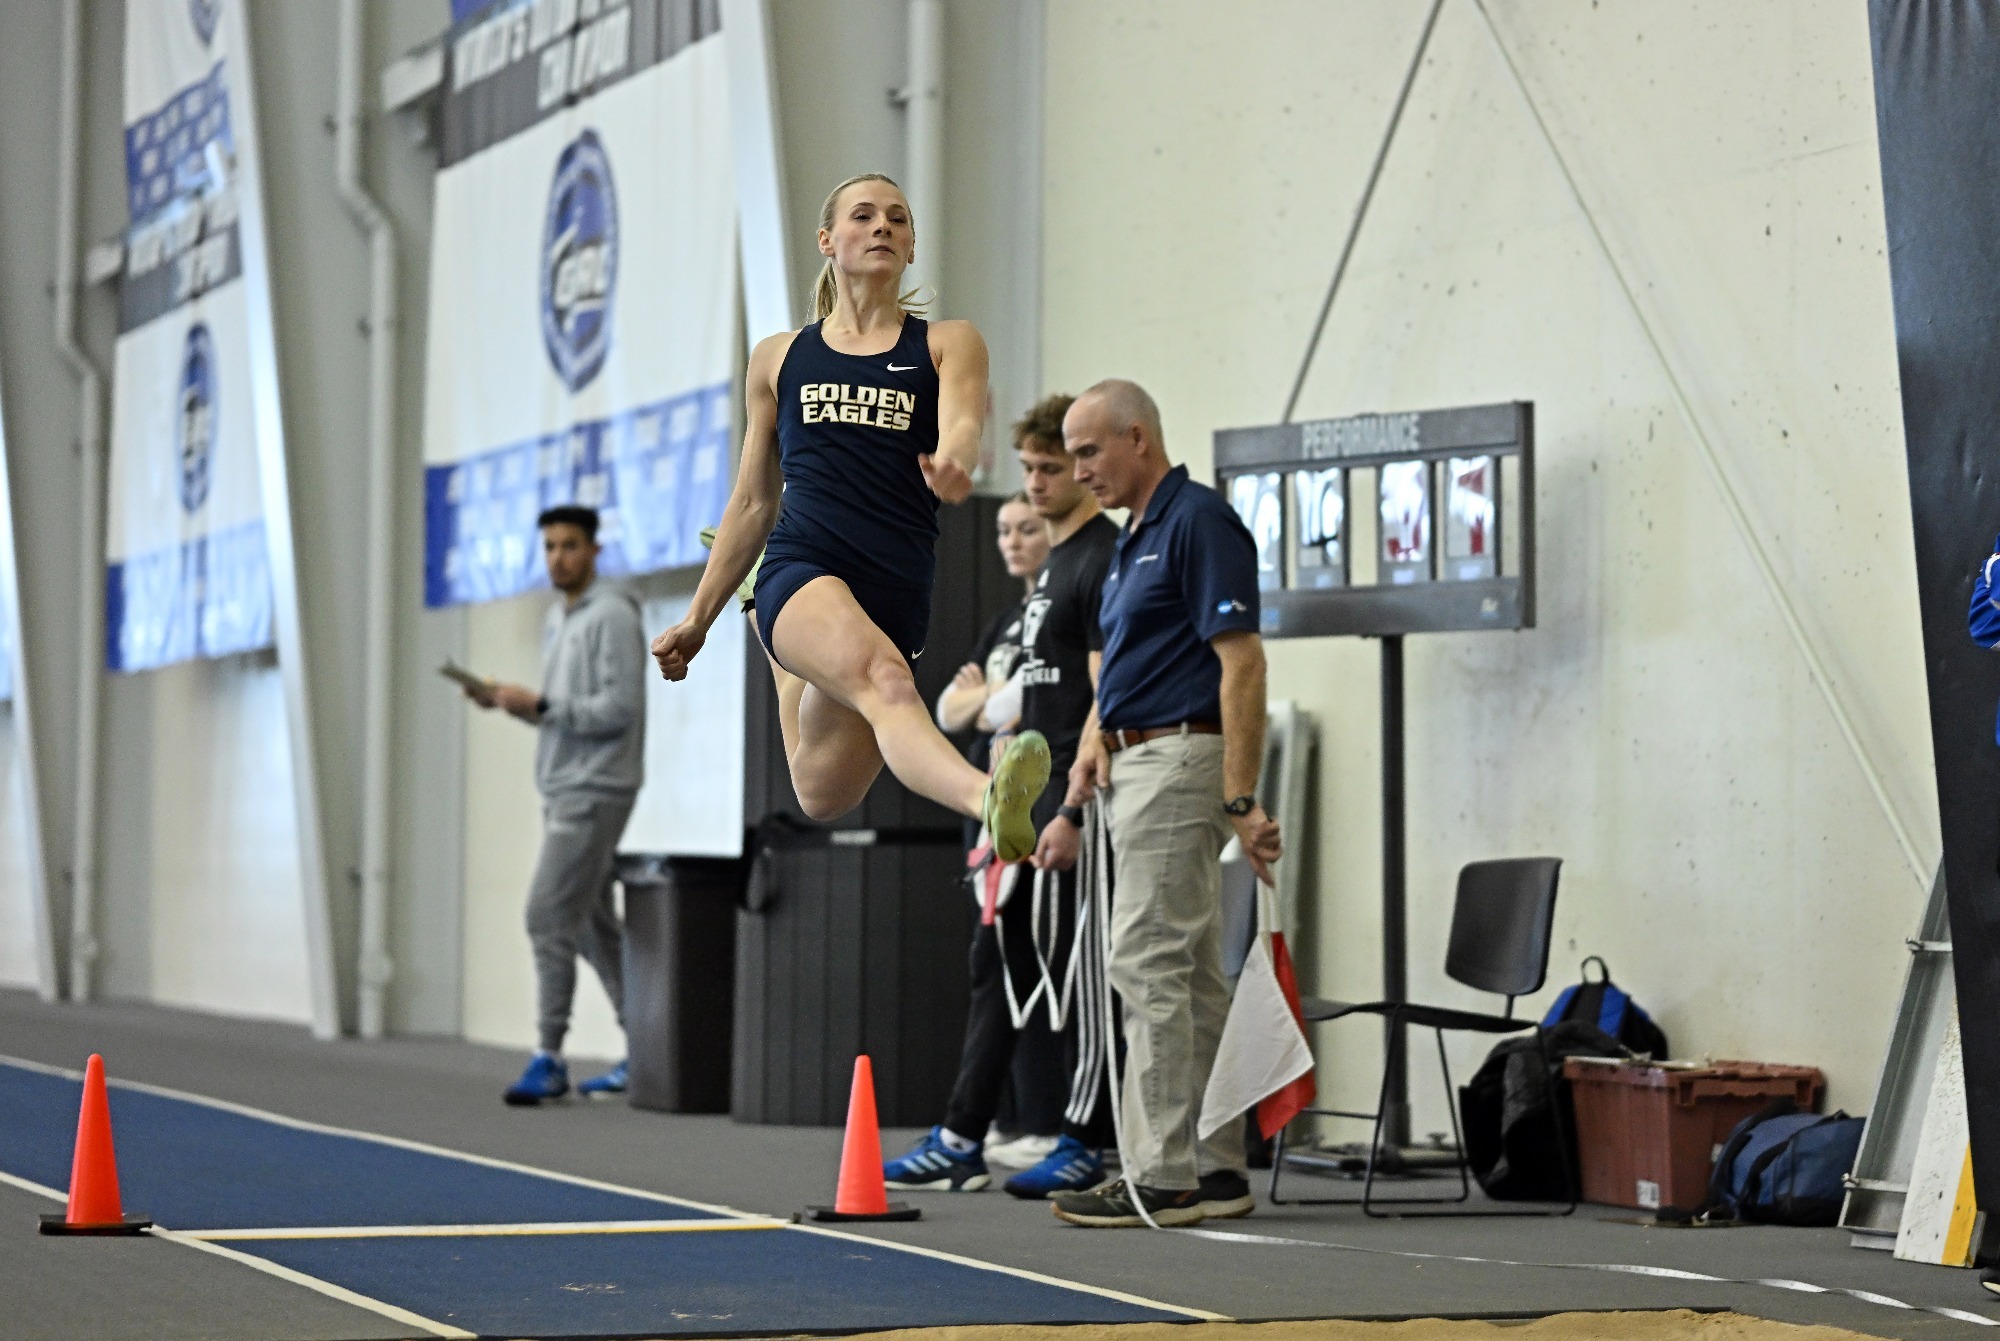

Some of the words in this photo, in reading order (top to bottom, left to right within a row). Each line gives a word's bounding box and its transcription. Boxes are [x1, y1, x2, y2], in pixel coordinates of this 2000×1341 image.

[800, 383, 916, 413] GOLDEN
[802, 403, 911, 431] EAGLES
[1302, 413, 1420, 460] PERFORMANCE
